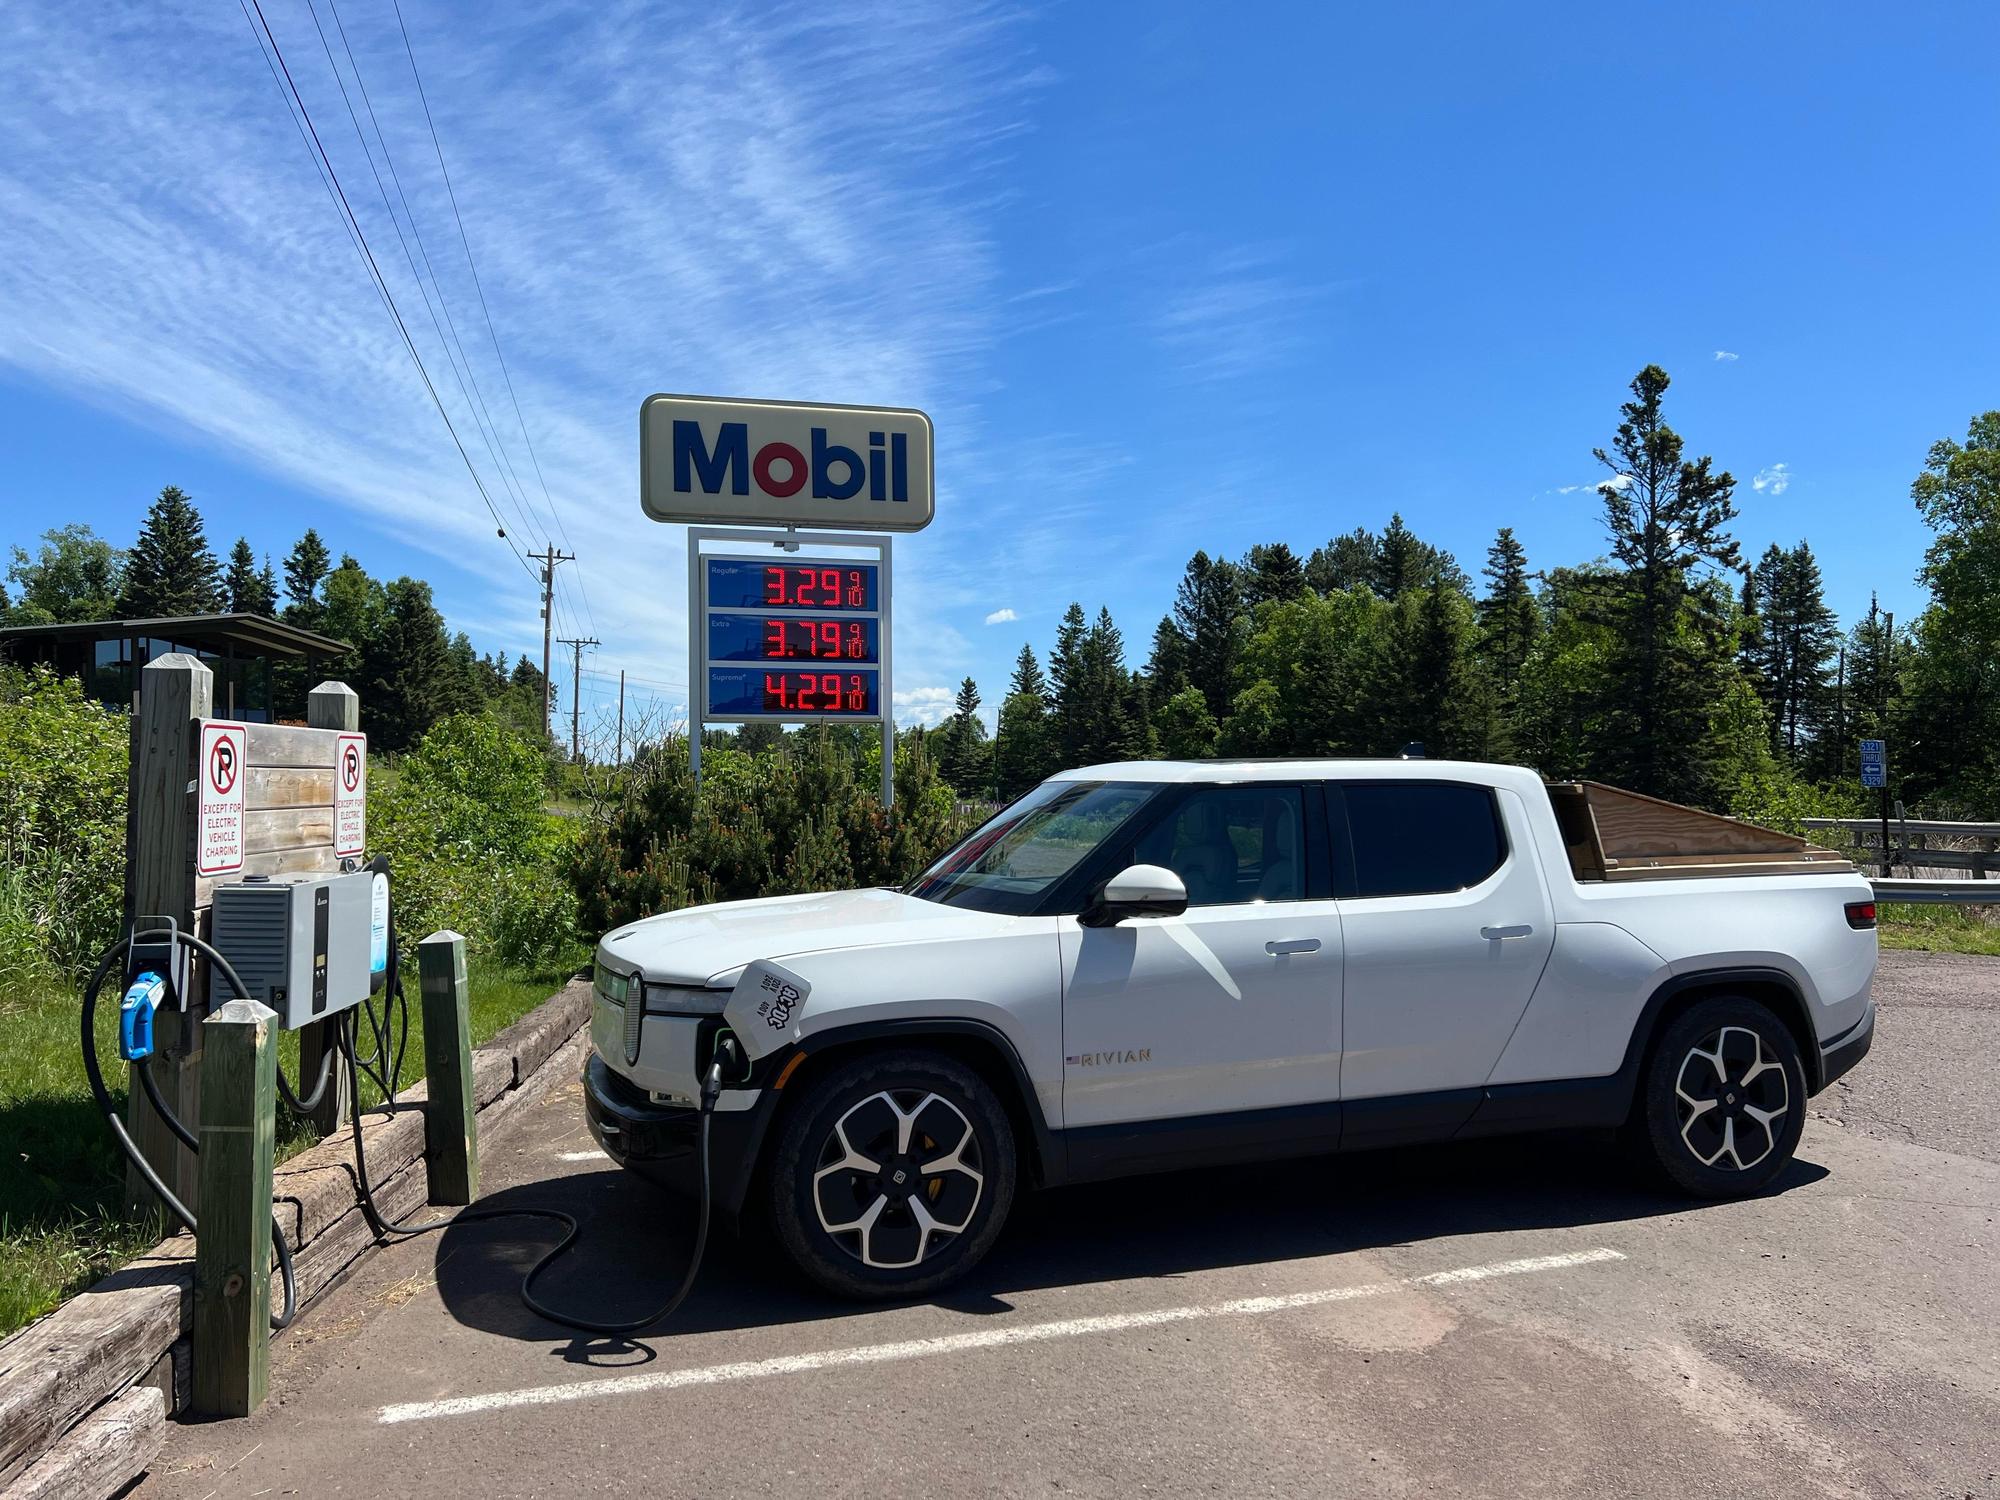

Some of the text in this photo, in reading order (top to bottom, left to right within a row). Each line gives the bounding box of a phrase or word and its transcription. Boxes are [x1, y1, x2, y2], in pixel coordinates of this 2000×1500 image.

[672, 420, 908, 502] Mobil
[711, 566, 739, 575] Regular
[767, 567, 841, 606] 3.29
[711, 619, 731, 628] Extra
[767, 621, 841, 658] 3.79
[766, 674, 841, 710] 4.29
[1861, 742, 1879, 751] 5321
[1863, 753, 1880, 762] THRU
[1862, 776, 1881, 785] 5329
[203, 803, 242, 815] EXCEPT FOR
[337, 800, 354, 809] EXCEPT
[340, 811, 361, 821] ELECTRIC
[207, 817, 238, 829] ELECTRIC
[341, 822, 360, 832] VEHICLE
[208, 831, 236, 843] VEHICLE
[339, 833, 361, 844] CHARGING
[205, 845, 238, 857] CHARGING
[1081, 1048, 1152, 1067] RIVIAN
